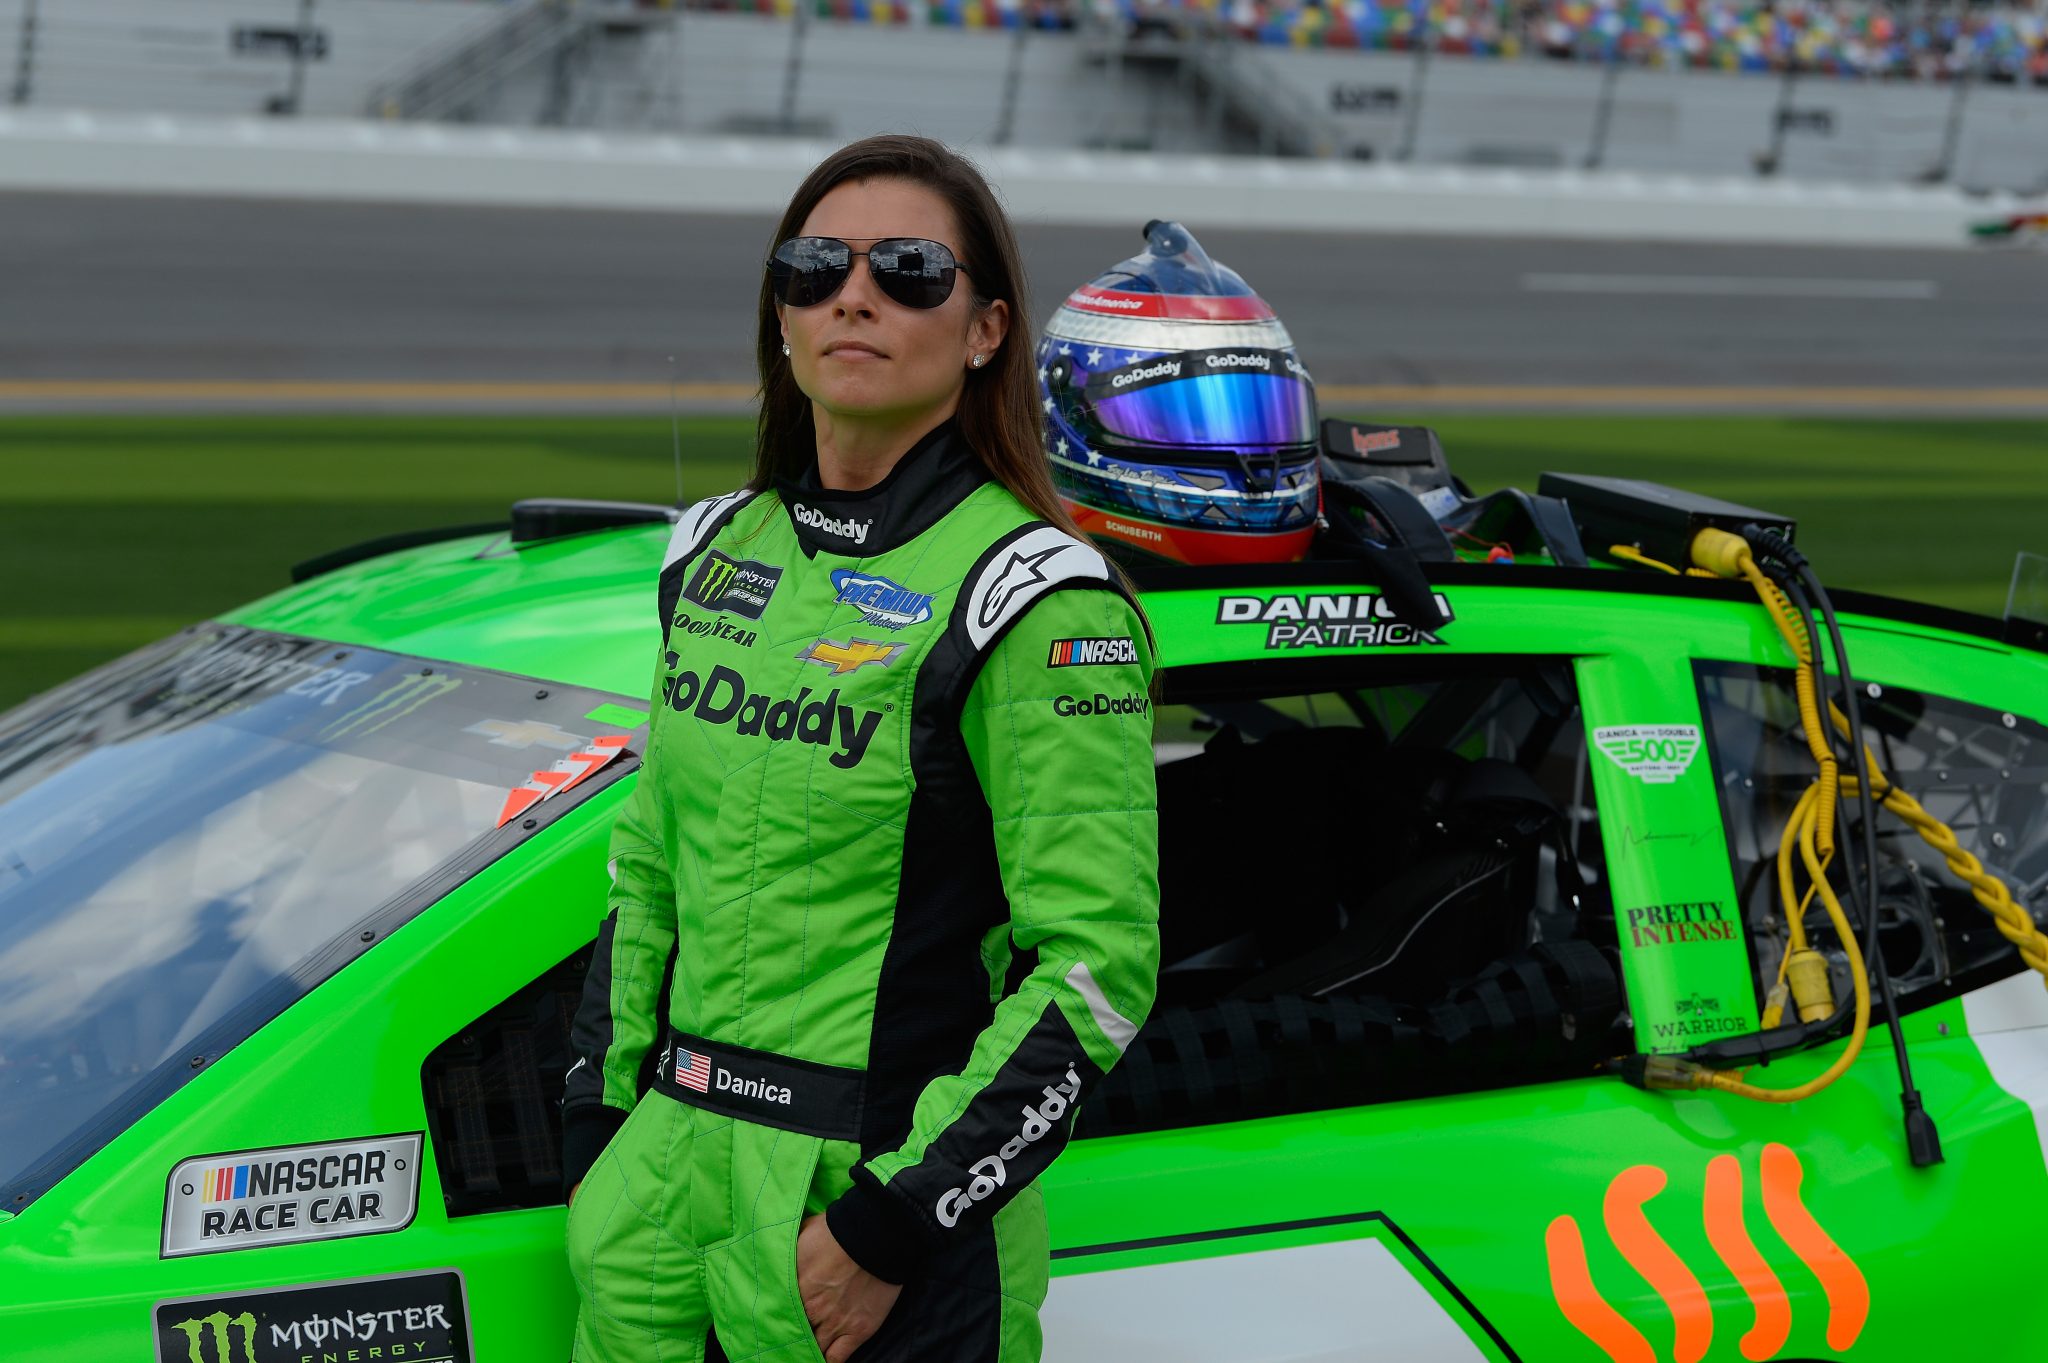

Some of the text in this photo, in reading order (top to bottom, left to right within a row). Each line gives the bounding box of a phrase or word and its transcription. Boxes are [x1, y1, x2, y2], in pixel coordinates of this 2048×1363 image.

[1111, 360, 1182, 388] GoDaddy
[1205, 353, 1271, 369] GoDaddy
[793, 503, 869, 544] GoDaddy
[1105, 520, 1162, 542] SCHUBERTH
[733, 569, 776, 589] MONSTER
[672, 610, 757, 647] OODYEAR
[1080, 640, 1138, 662] NASCA
[1053, 693, 1149, 720] GoDaddy
[1598, 729, 1638, 740] DANICA
[1657, 728, 1695, 737] DOUBLE
[1624, 738, 1677, 763] 500
[1627, 901, 1725, 929] PRETTY
[1631, 920, 1738, 948] INTENSE
[1654, 1017, 1748, 1037] WARRIOR
[716, 1068, 791, 1105] Danica
[936, 1068, 1081, 1228] GoDaddy
[248, 1151, 387, 1198] NASCAR
[202, 1193, 381, 1238] RACE CAR
[269, 1304, 452, 1350] MONSTER
[301, 1341, 426, 1363] ENERGY
